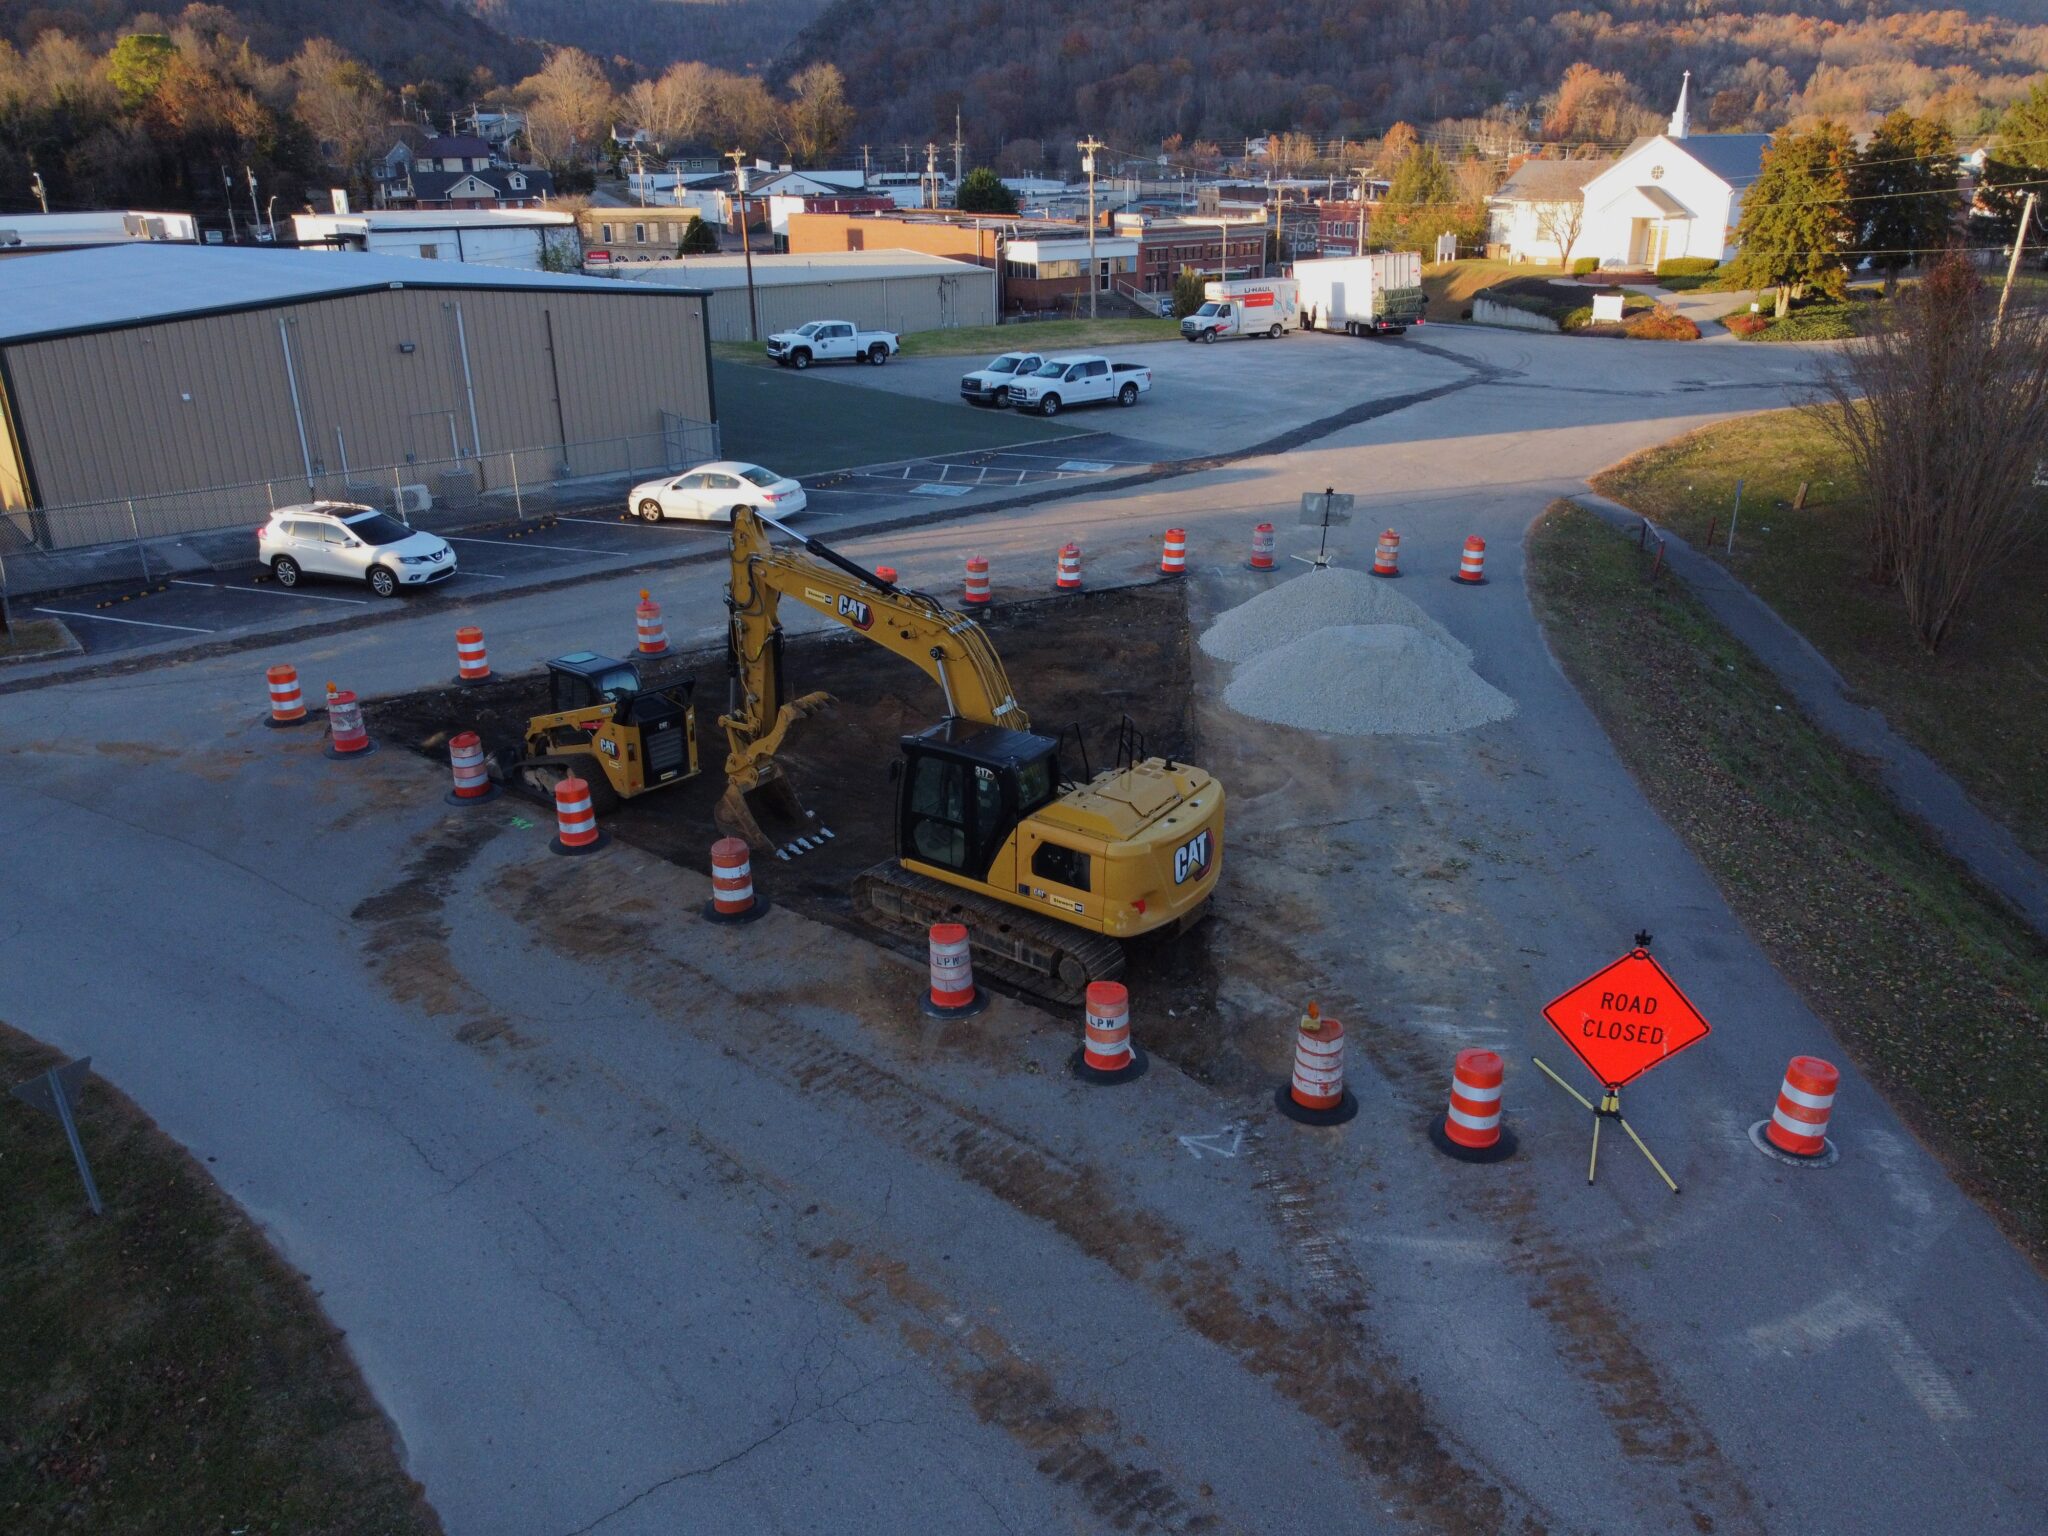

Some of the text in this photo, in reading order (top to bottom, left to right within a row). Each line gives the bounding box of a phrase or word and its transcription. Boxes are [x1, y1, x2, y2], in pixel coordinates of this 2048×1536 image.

[1244, 286, 1272, 294] U-HAUL
[839, 594, 867, 623] CAT
[600, 739, 616, 756] CAT
[1174, 831, 1207, 883] CAT
[1033, 887, 1045, 898] CAT
[936, 956, 960, 966] LPW
[1600, 992, 1657, 1015] ROAD
[1089, 1016, 1115, 1028] LPW
[1583, 1019, 1664, 1045] CLOSED
